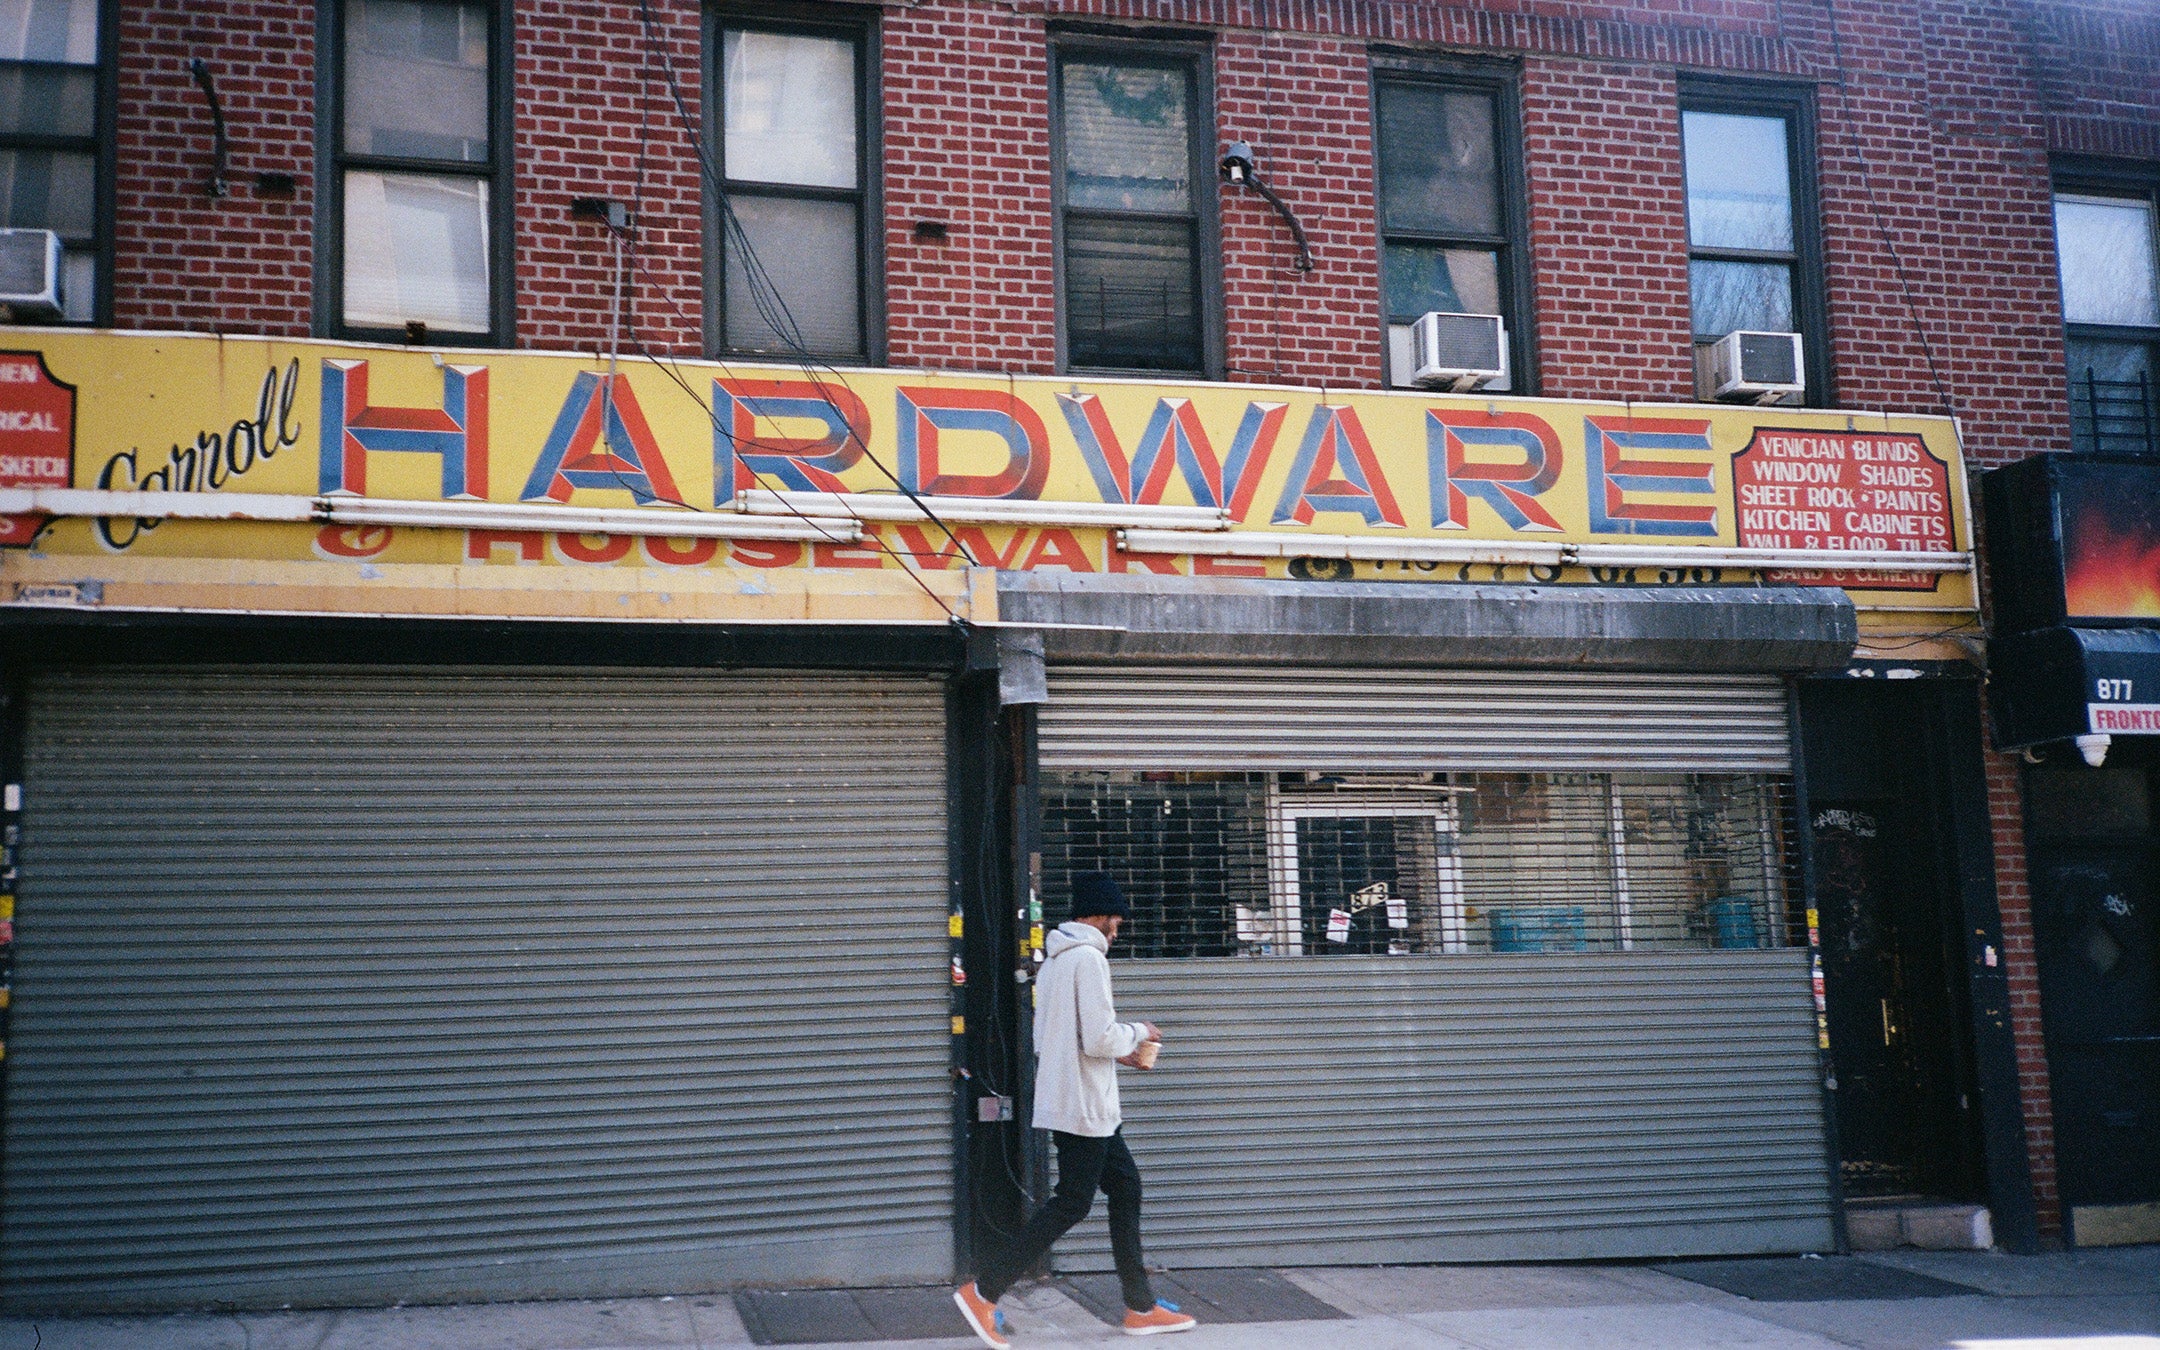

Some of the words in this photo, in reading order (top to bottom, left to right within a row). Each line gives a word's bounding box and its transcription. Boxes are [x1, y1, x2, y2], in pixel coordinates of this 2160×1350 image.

[95, 356, 301, 550] Carroll
[318, 357, 1720, 536] HARDWARE
[1761, 436, 1845, 459] VENICIAN
[1853, 440, 1920, 463] BLINDS
[1752, 460, 1841, 483] WINDOW
[1860, 464, 1934, 488] SHADES
[1740, 484, 1801, 506] SHEET
[1807, 486, 1856, 509] ROCK
[1873, 489, 1943, 512] PAINTS
[1743, 509, 1831, 532] KITCHEN
[1845, 511, 1946, 537] CABINETS
[2097, 678, 2132, 700] 877
